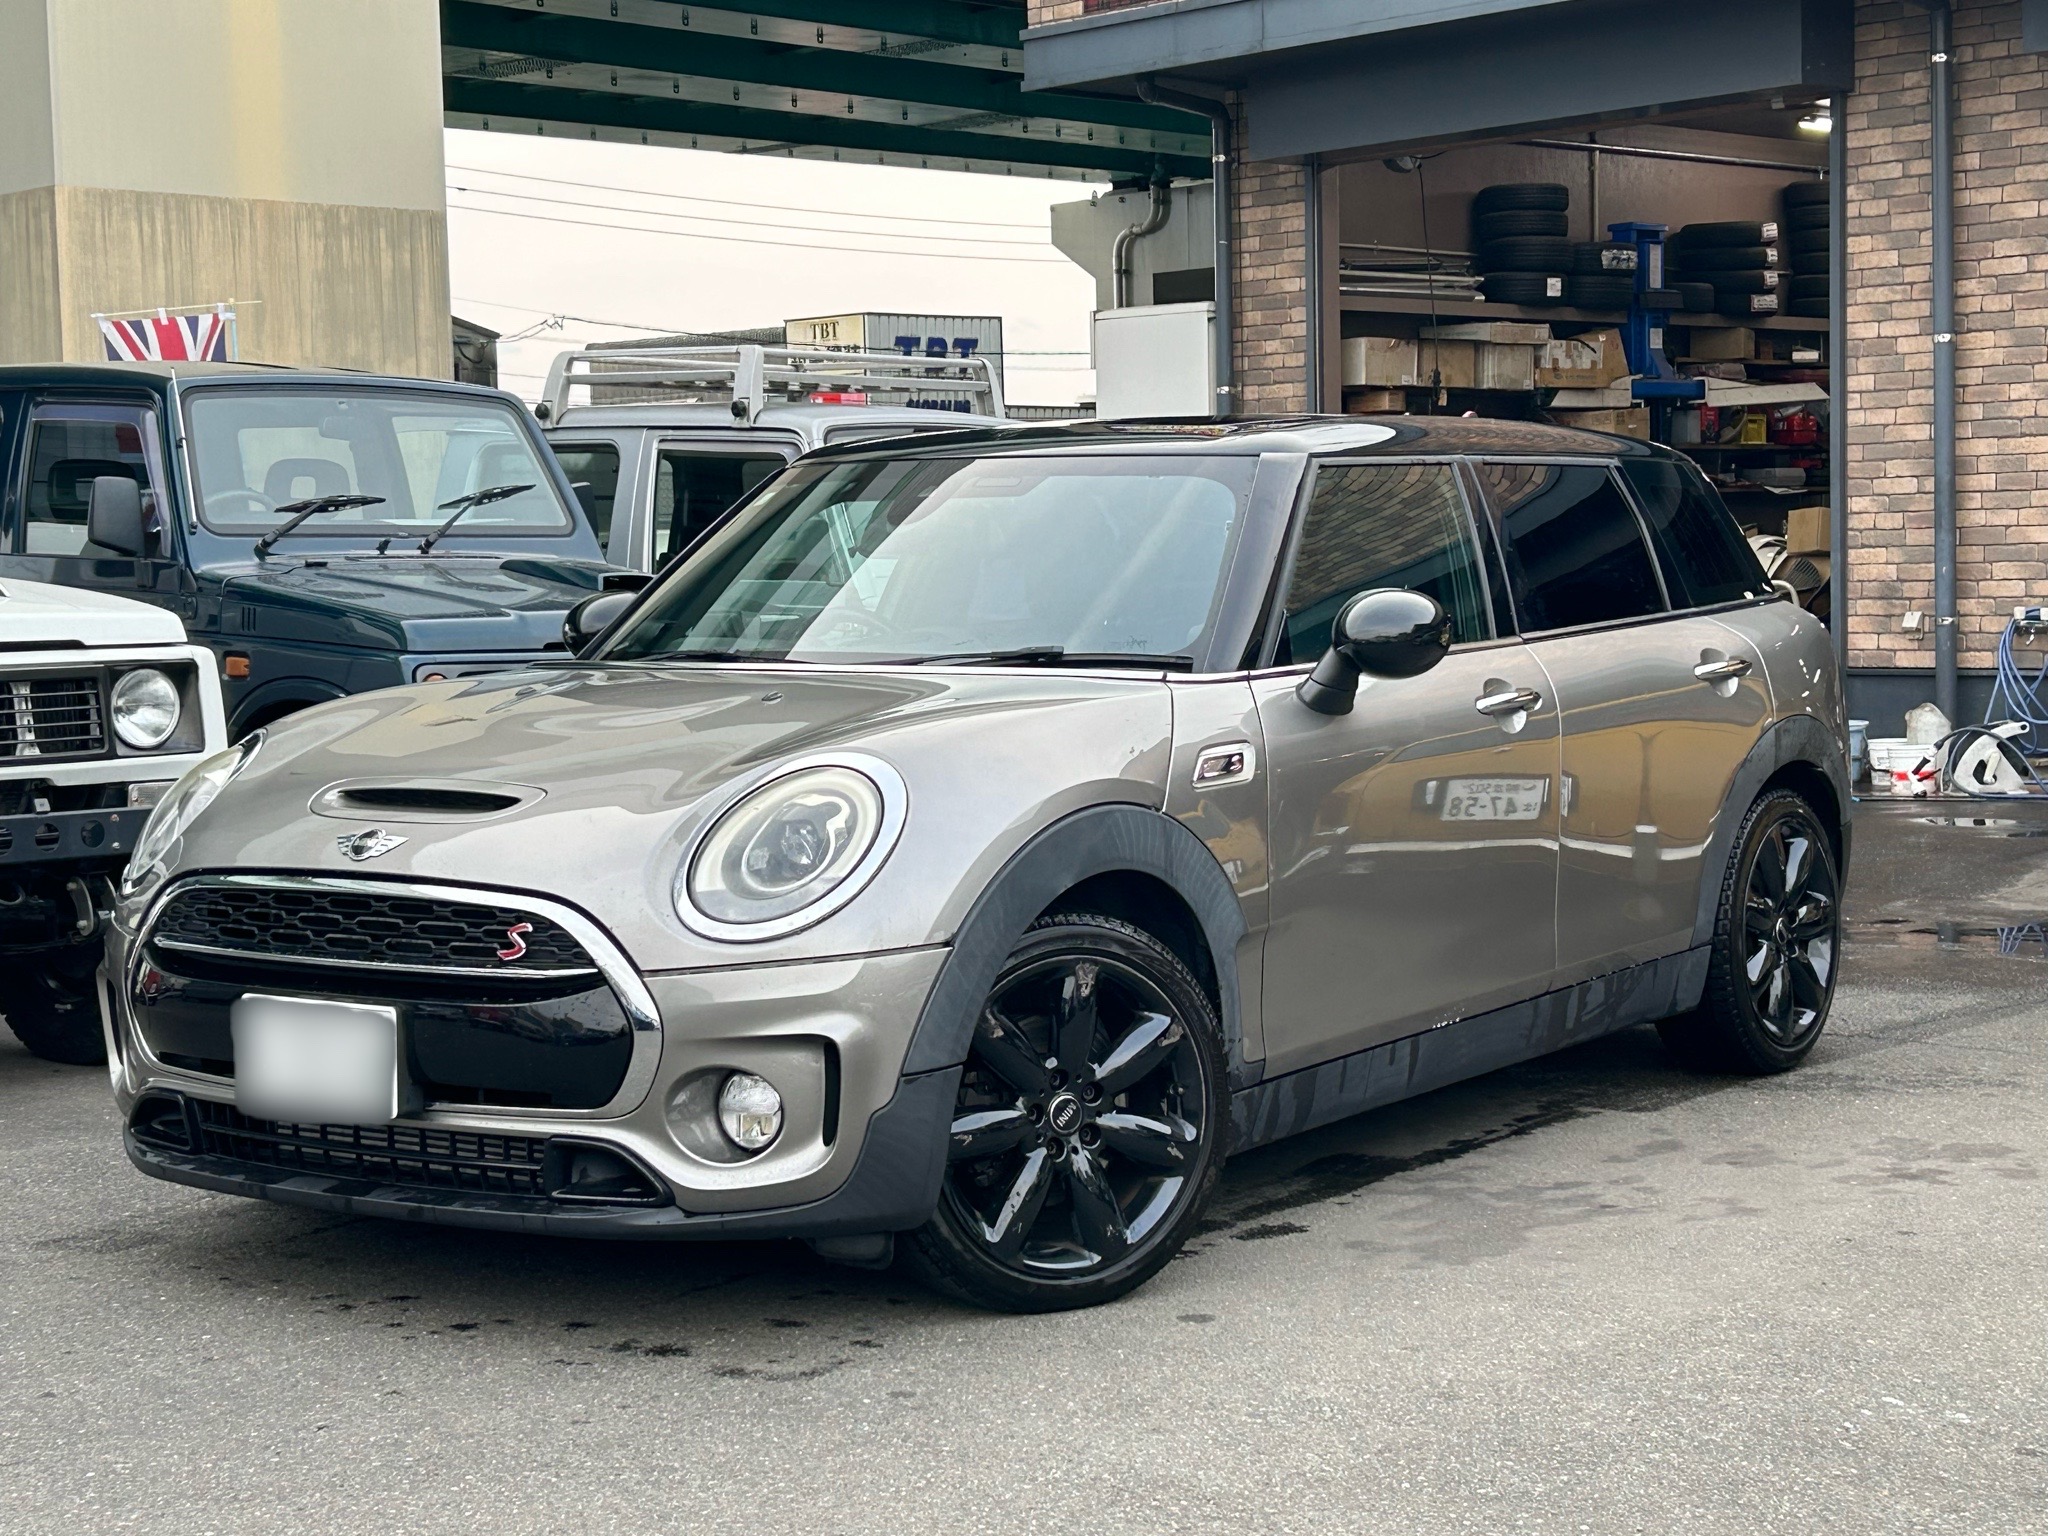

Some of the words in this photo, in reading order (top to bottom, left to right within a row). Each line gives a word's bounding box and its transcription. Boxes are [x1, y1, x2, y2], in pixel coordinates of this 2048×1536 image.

[810, 321, 839, 340] TBT
[496, 922, 533, 961] S
[1056, 1102, 1077, 1127] MINI
